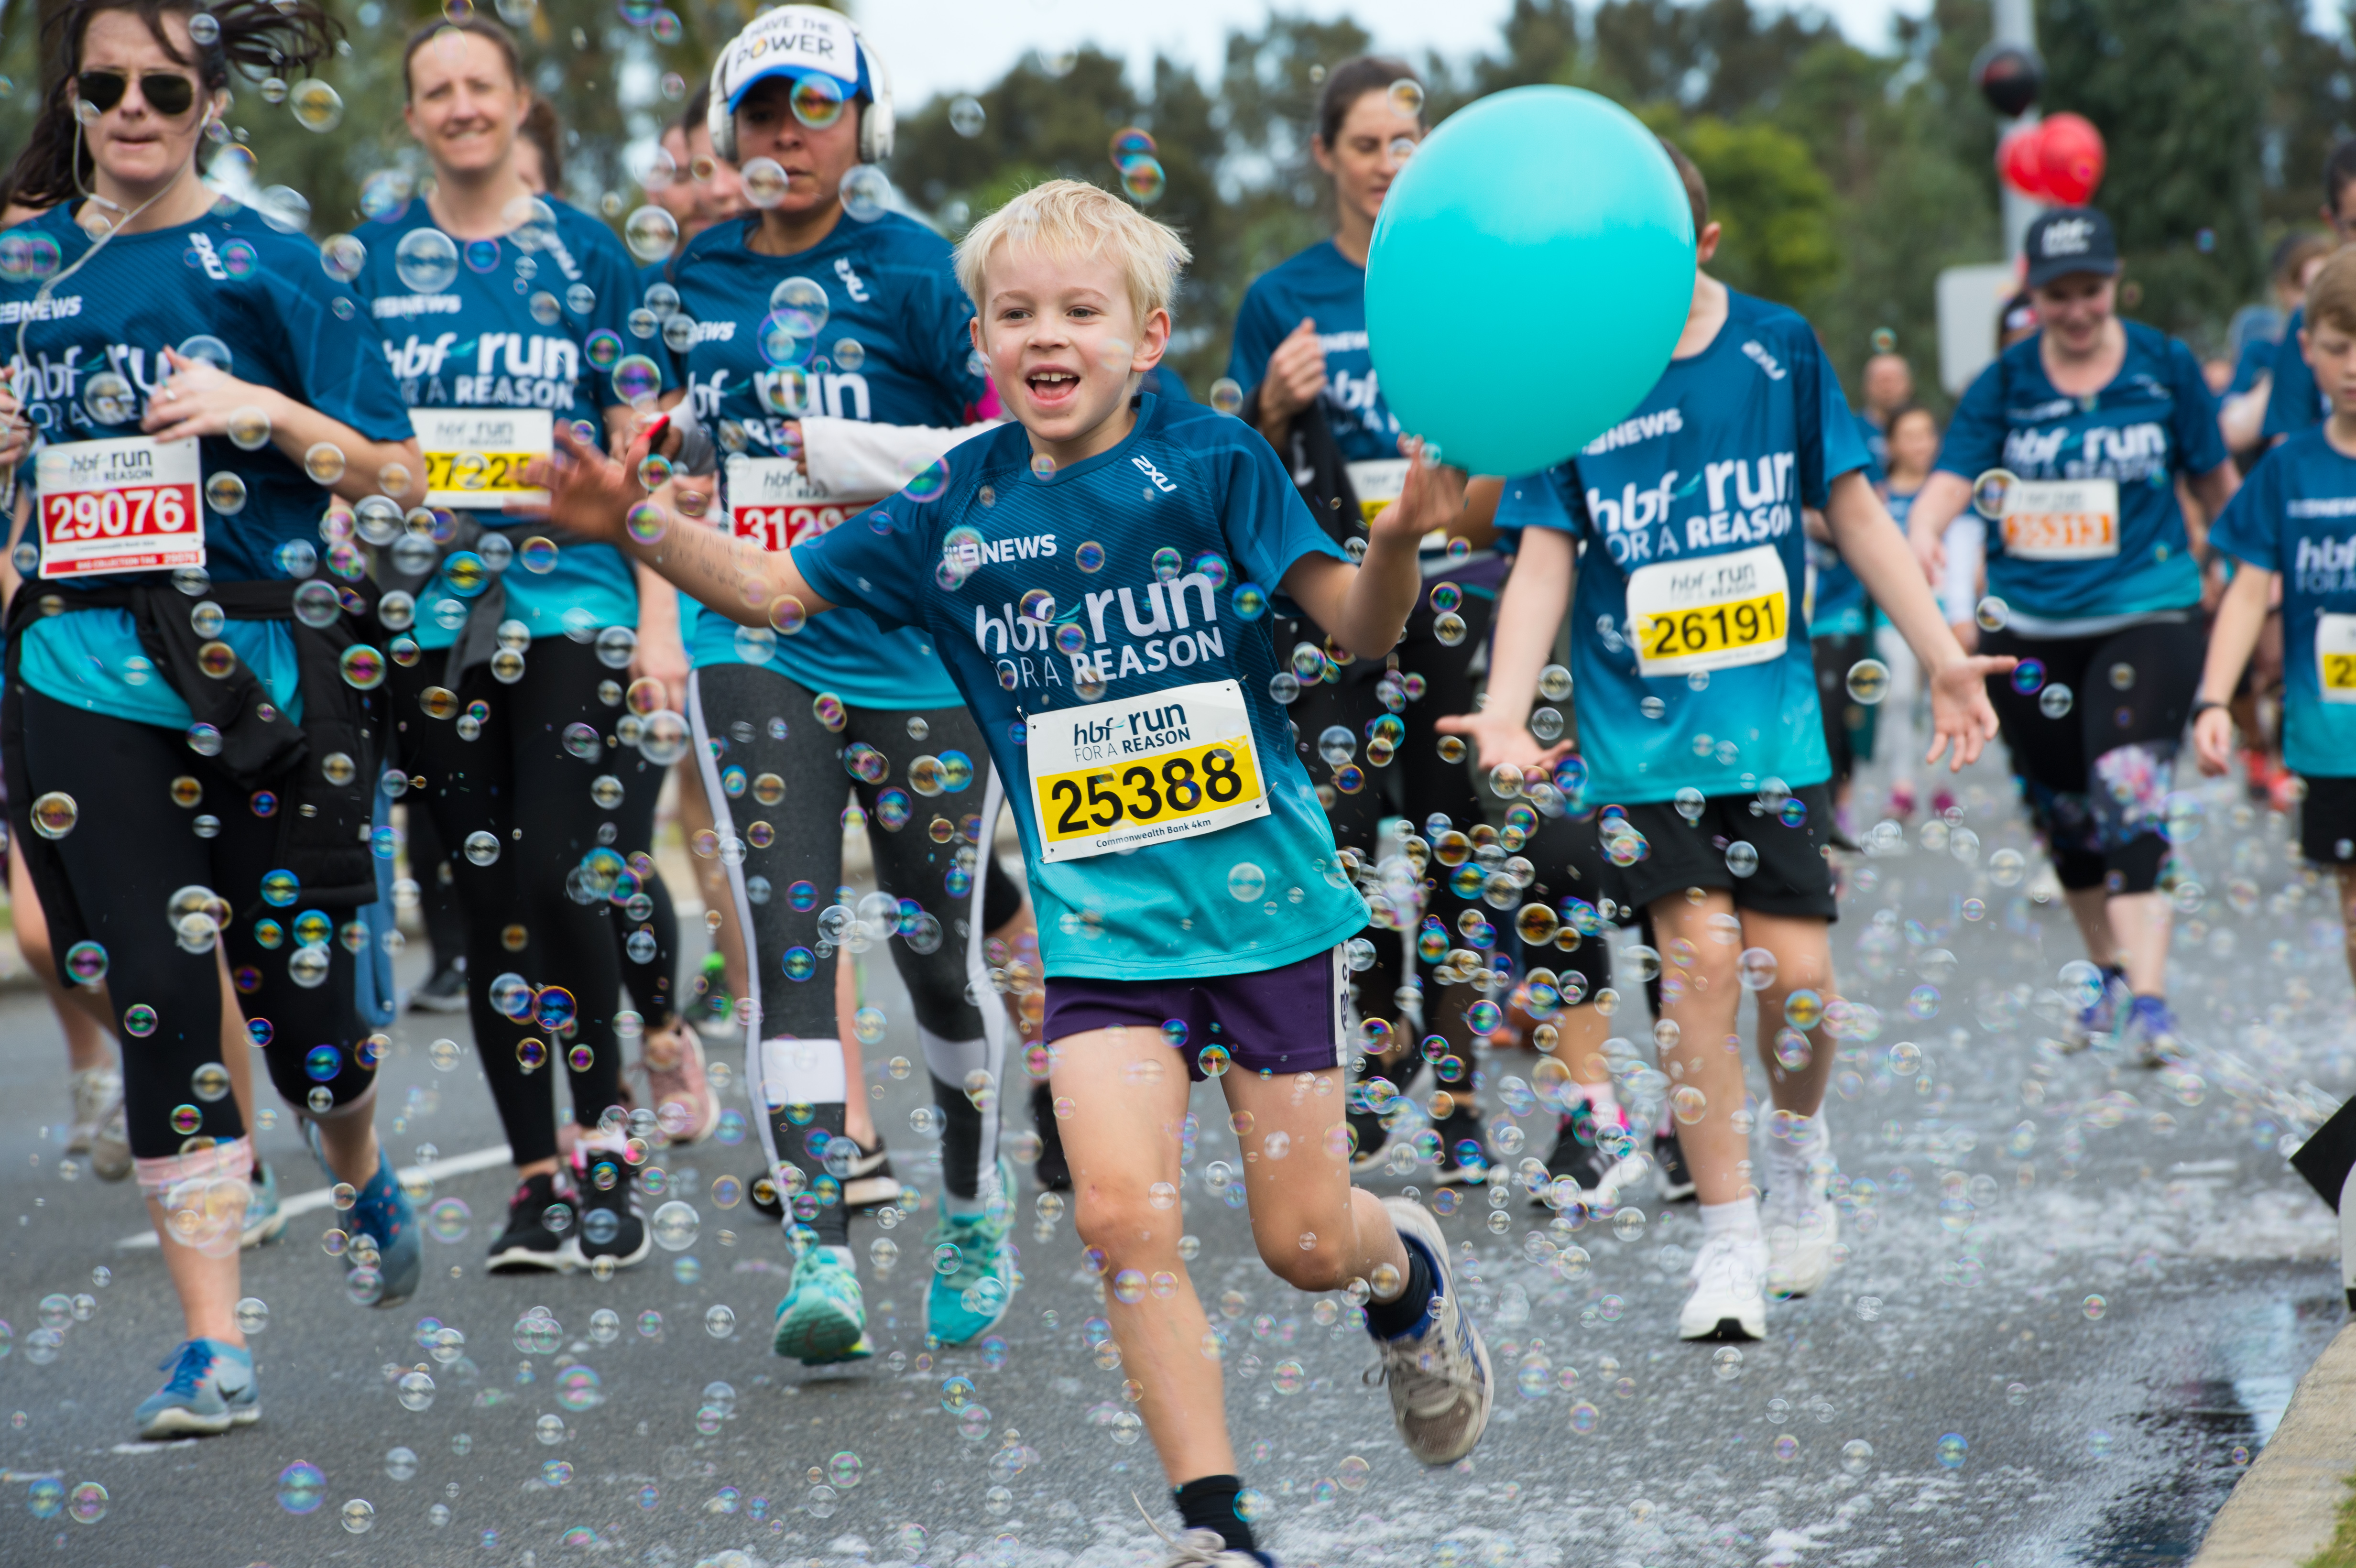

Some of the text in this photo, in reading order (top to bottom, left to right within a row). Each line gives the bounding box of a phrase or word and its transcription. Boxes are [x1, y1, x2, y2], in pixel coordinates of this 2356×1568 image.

[802, 17, 832, 34] THE
[737, 34, 834, 66] POWER
[10, 343, 172, 403] hbf ru
[478, 333, 579, 380] run
[454, 375, 576, 410] REASON
[687, 368, 872, 422] bf run
[28, 402, 64, 432] OR
[111, 449, 153, 468] run
[2083, 422, 2168, 463] run
[105, 469, 153, 482] REASON
[1131, 455, 1178, 492] 2XU
[50, 487, 185, 541] 29076
[1586, 471, 1679, 534] hbf
[1606, 529, 1652, 565] OR
[1717, 563, 1755, 583] run
[975, 571, 1218, 656] hbf run
[1655, 599, 1776, 655] 26191
[1045, 656, 1063, 687] A
[1070, 626, 1225, 685] REASON
[1074, 703, 1187, 746] hbf run
[1074, 727, 1191, 762] FOR A REASON
[1051, 748, 1242, 834] 25388
[1096, 817, 1211, 848] Commonwealth Bank 4km
